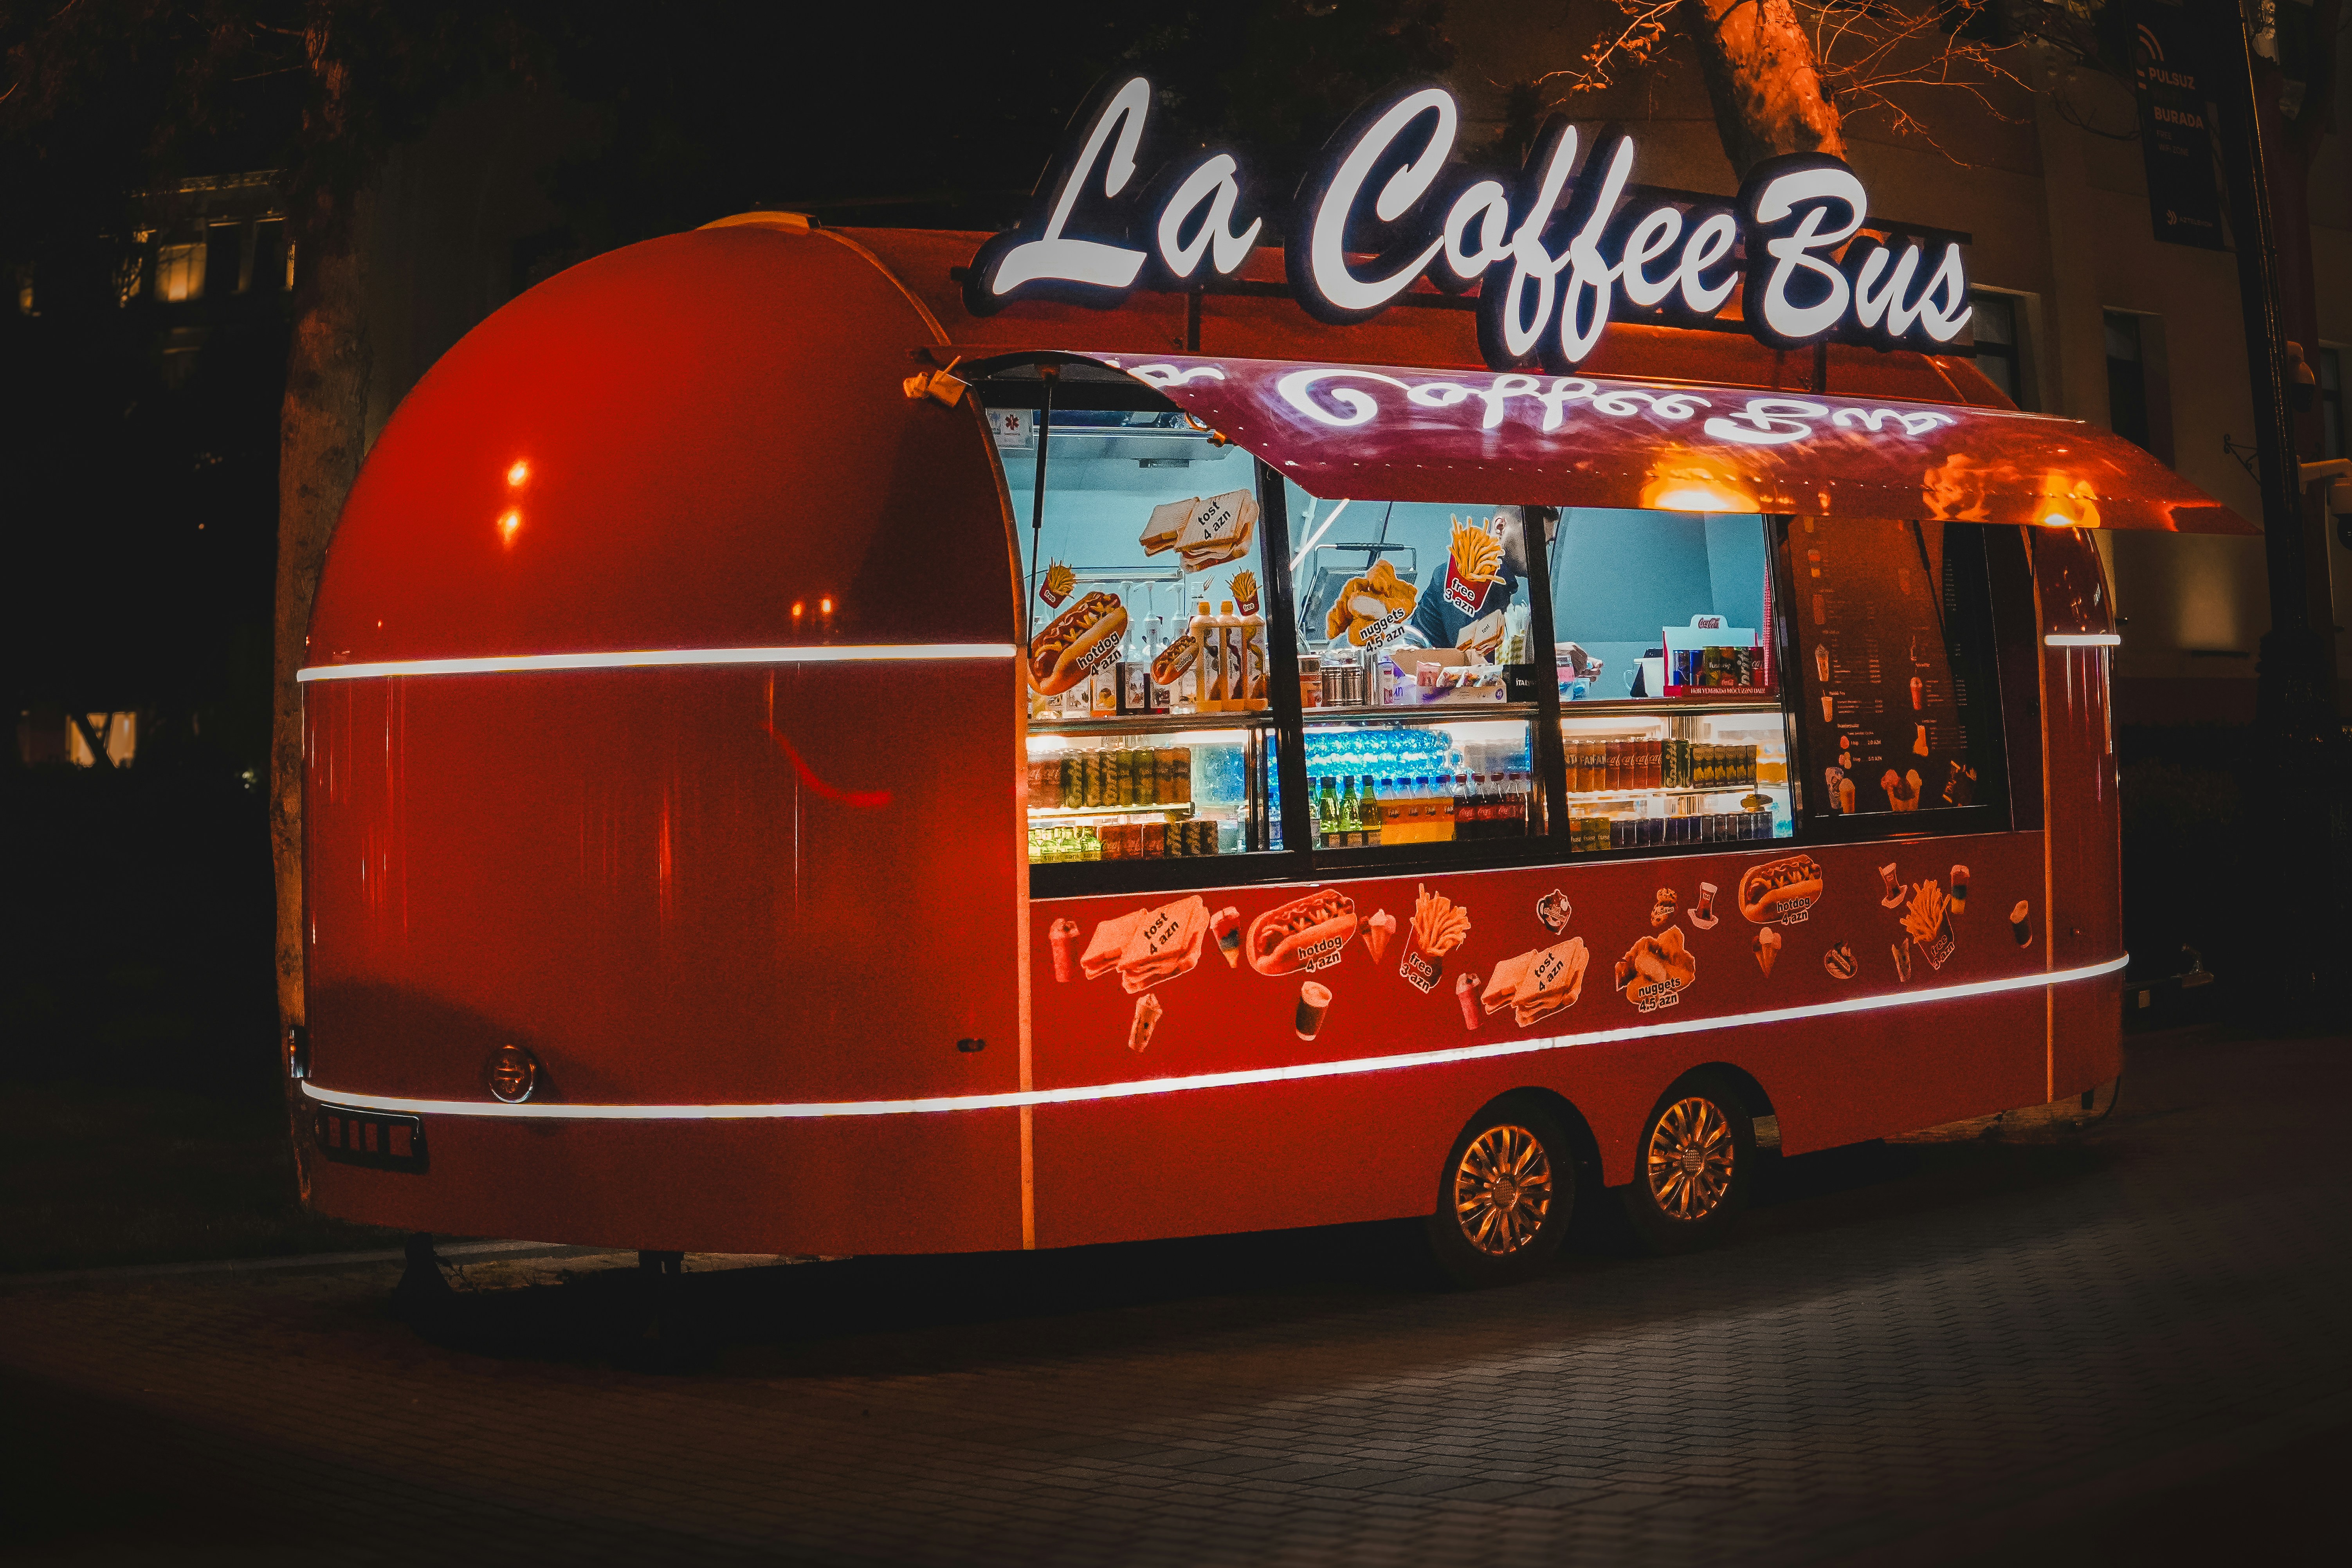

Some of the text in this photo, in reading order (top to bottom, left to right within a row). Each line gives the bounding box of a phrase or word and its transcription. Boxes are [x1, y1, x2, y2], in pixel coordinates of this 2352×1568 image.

[2148, 67, 2195, 90] PULSUZ
[2154, 106, 2204, 130] BURADA
[2156, 130, 2172, 140] FREE
[993, 76, 1973, 359] La Coffee Bus
[1197, 500, 1221, 526] tost
[1203, 510, 1231, 540] 4 azn
[1045, 590, 1056, 602] free
[1451, 578, 1475, 601] free
[1244, 603, 1254, 611] free
[1444, 588, 1474, 616] 3 azn
[1360, 607, 1404, 640] nuggets
[1078, 633, 1120, 669] hotdog
[1366, 625, 1405, 654] 4.5 azn
[1091, 650, 1122, 676] 4 azn
[1777, 896, 1811, 913] hotdog
[1144, 912, 1169, 939] tost
[1782, 910, 1808, 925] 4 azn
[1150, 922, 1179, 955] 4 azn
[1298, 937, 1343, 960] hotdog
[1931, 935, 1947, 957] free
[1307, 952, 1341, 971] 4 azn
[1409, 952, 1433, 976] free
[1534, 953, 1555, 977] tost
[1933, 943, 1954, 970] 3 azn
[1401, 964, 1431, 992] 3 azn
[1539, 960, 1564, 991] 4 azn
[1638, 977, 1682, 997] nuggets
[1639, 993, 1678, 1012] 4.5 azn
